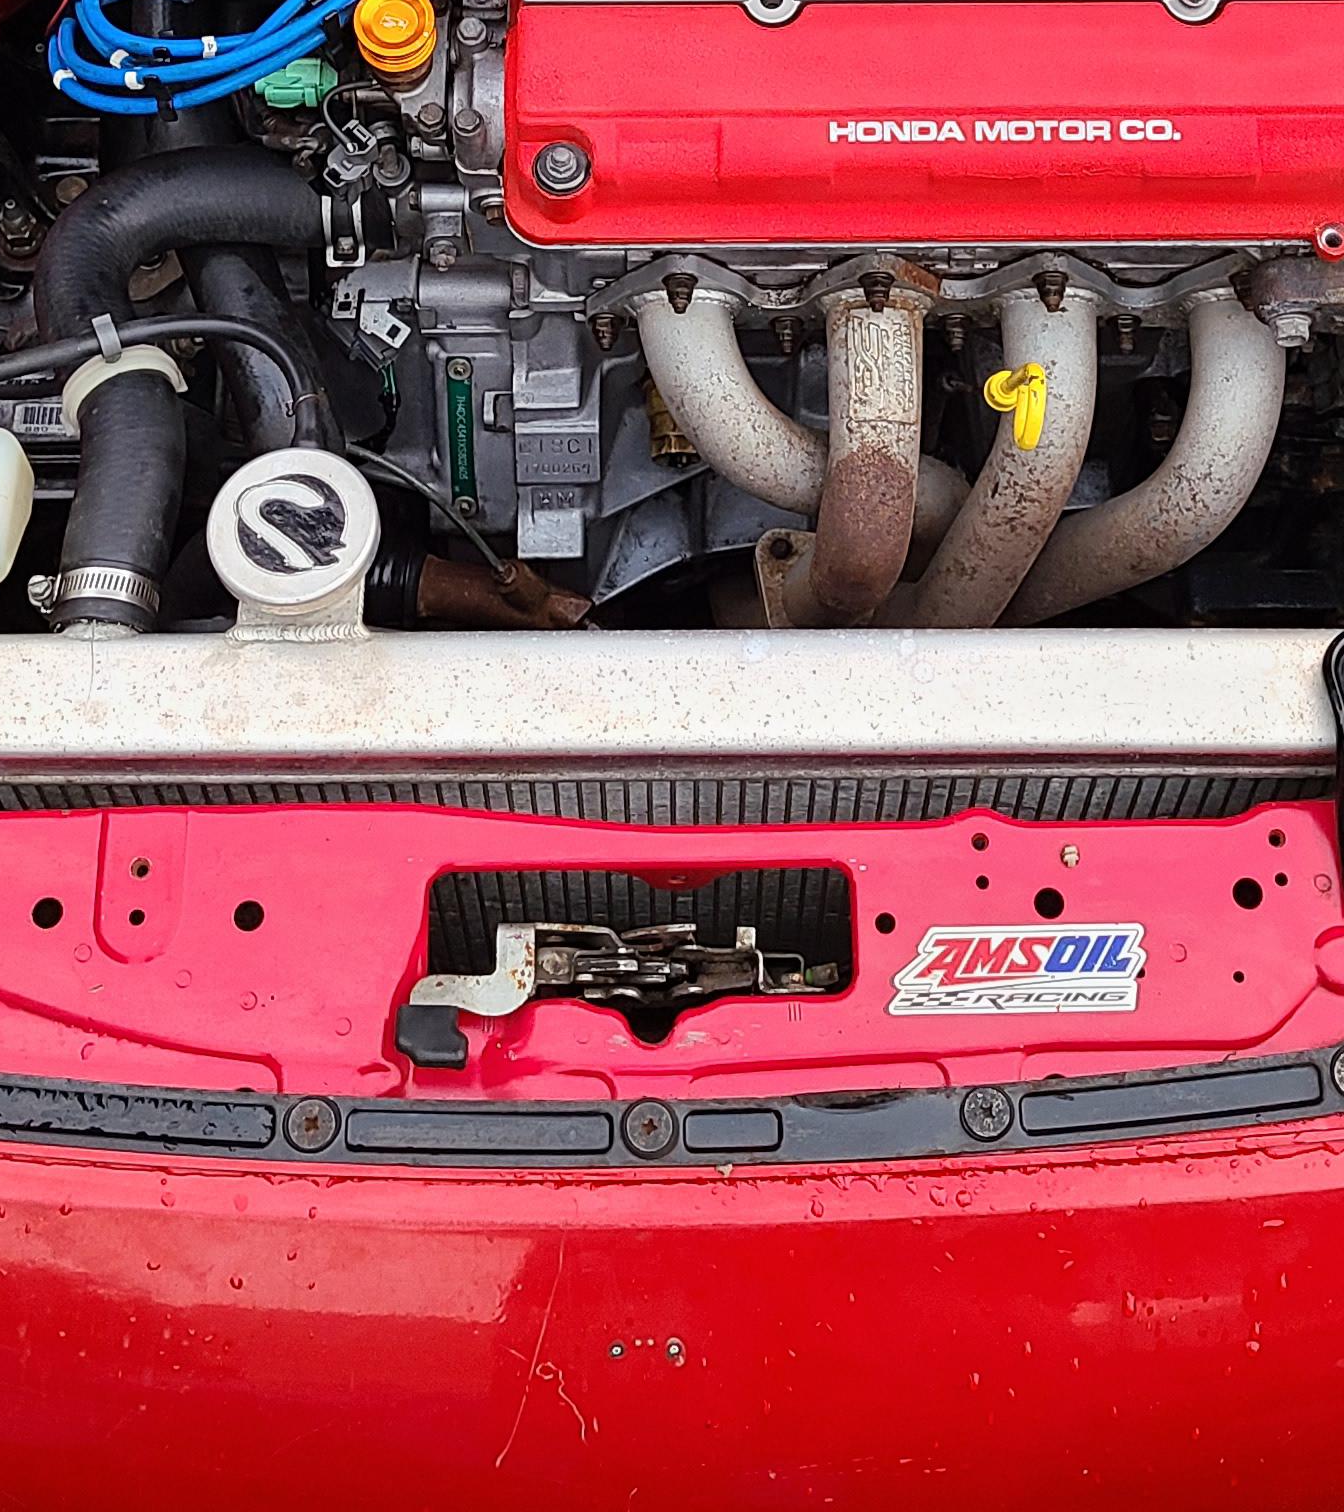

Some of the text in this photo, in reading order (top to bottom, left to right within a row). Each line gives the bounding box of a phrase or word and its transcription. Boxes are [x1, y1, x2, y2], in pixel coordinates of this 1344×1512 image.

[829, 119, 1182, 142] HONDA MOTOR CO.
[914, 935, 1133, 988] AMSOIL
[972, 991, 1129, 1010] RACING
